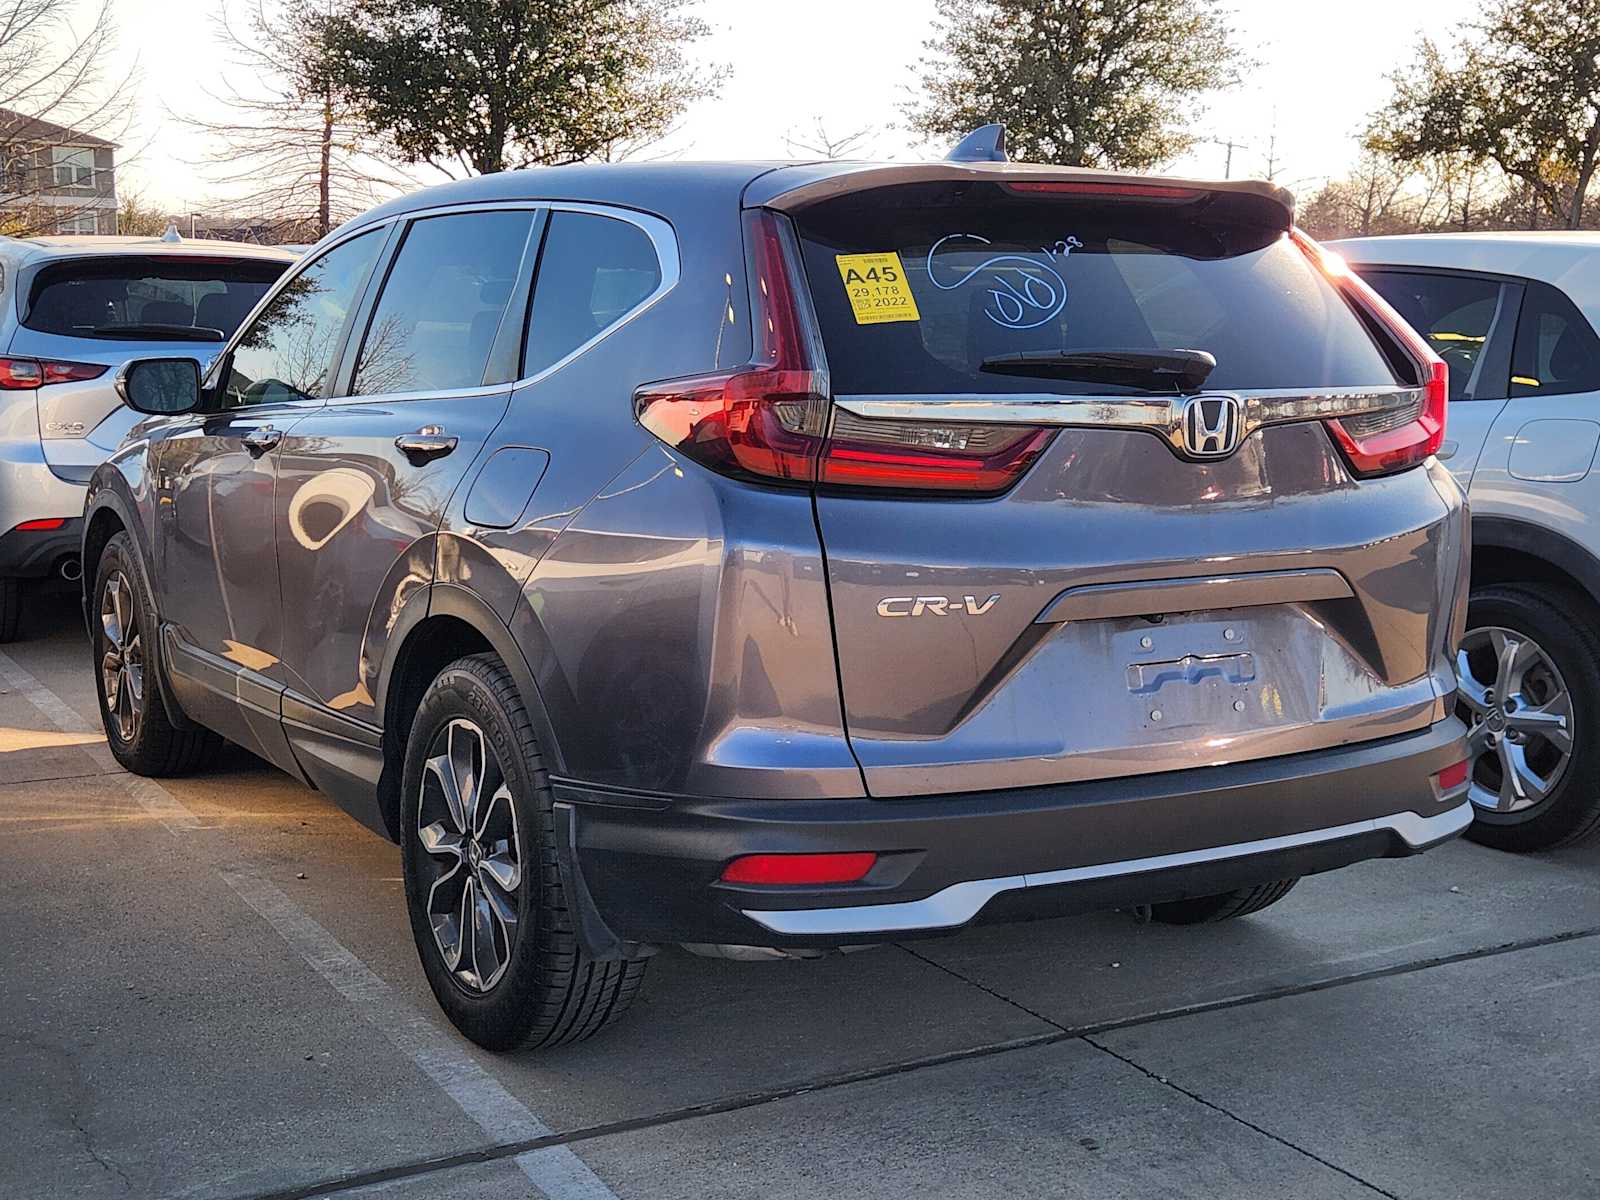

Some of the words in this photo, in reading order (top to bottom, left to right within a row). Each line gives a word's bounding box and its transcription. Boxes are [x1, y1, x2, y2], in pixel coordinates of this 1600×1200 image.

[845, 266, 898, 285] A45
[873, 296, 907, 308] 2022
[877, 594, 1001, 617] CR-V
